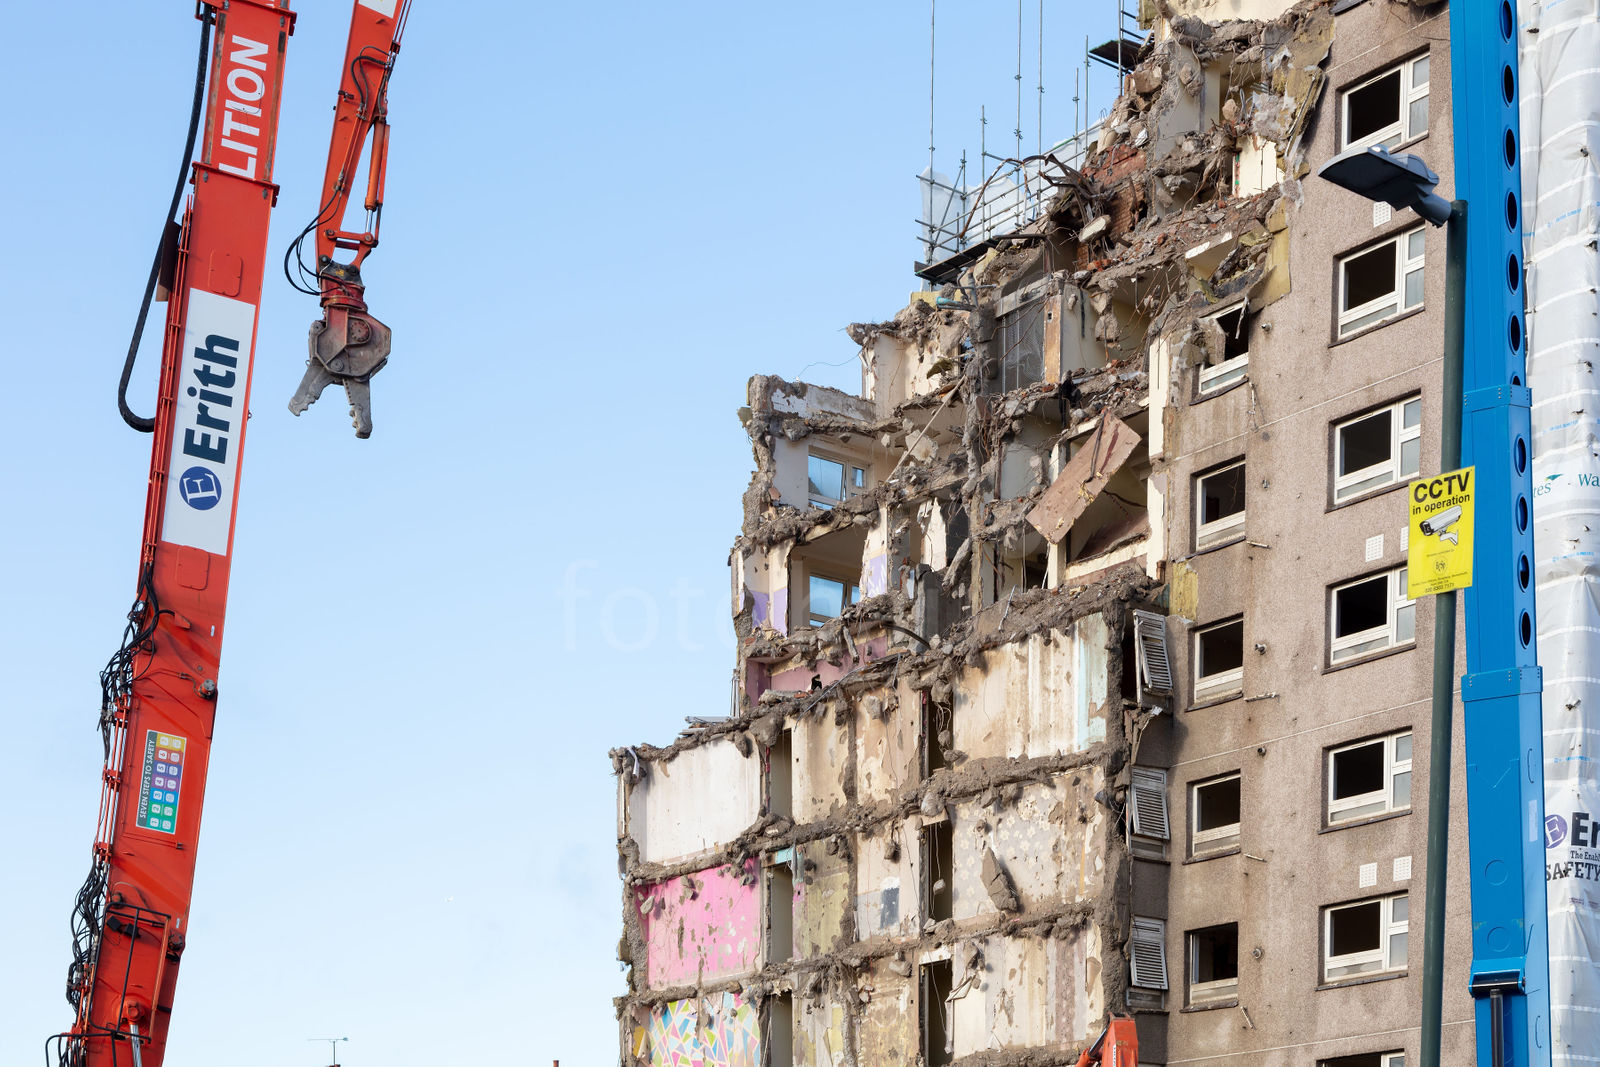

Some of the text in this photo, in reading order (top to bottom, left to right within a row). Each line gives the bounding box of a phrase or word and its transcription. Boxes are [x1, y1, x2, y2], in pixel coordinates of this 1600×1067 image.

[218, 34, 269, 179] LITION
[183, 334, 240, 464] Erith
[1412, 494, 1470, 515] in operation
[1413, 471, 1470, 503] CCTV
[140, 739, 155, 819] SEVEN STEPS TO SAFETY
[1570, 850, 1583, 860] The
